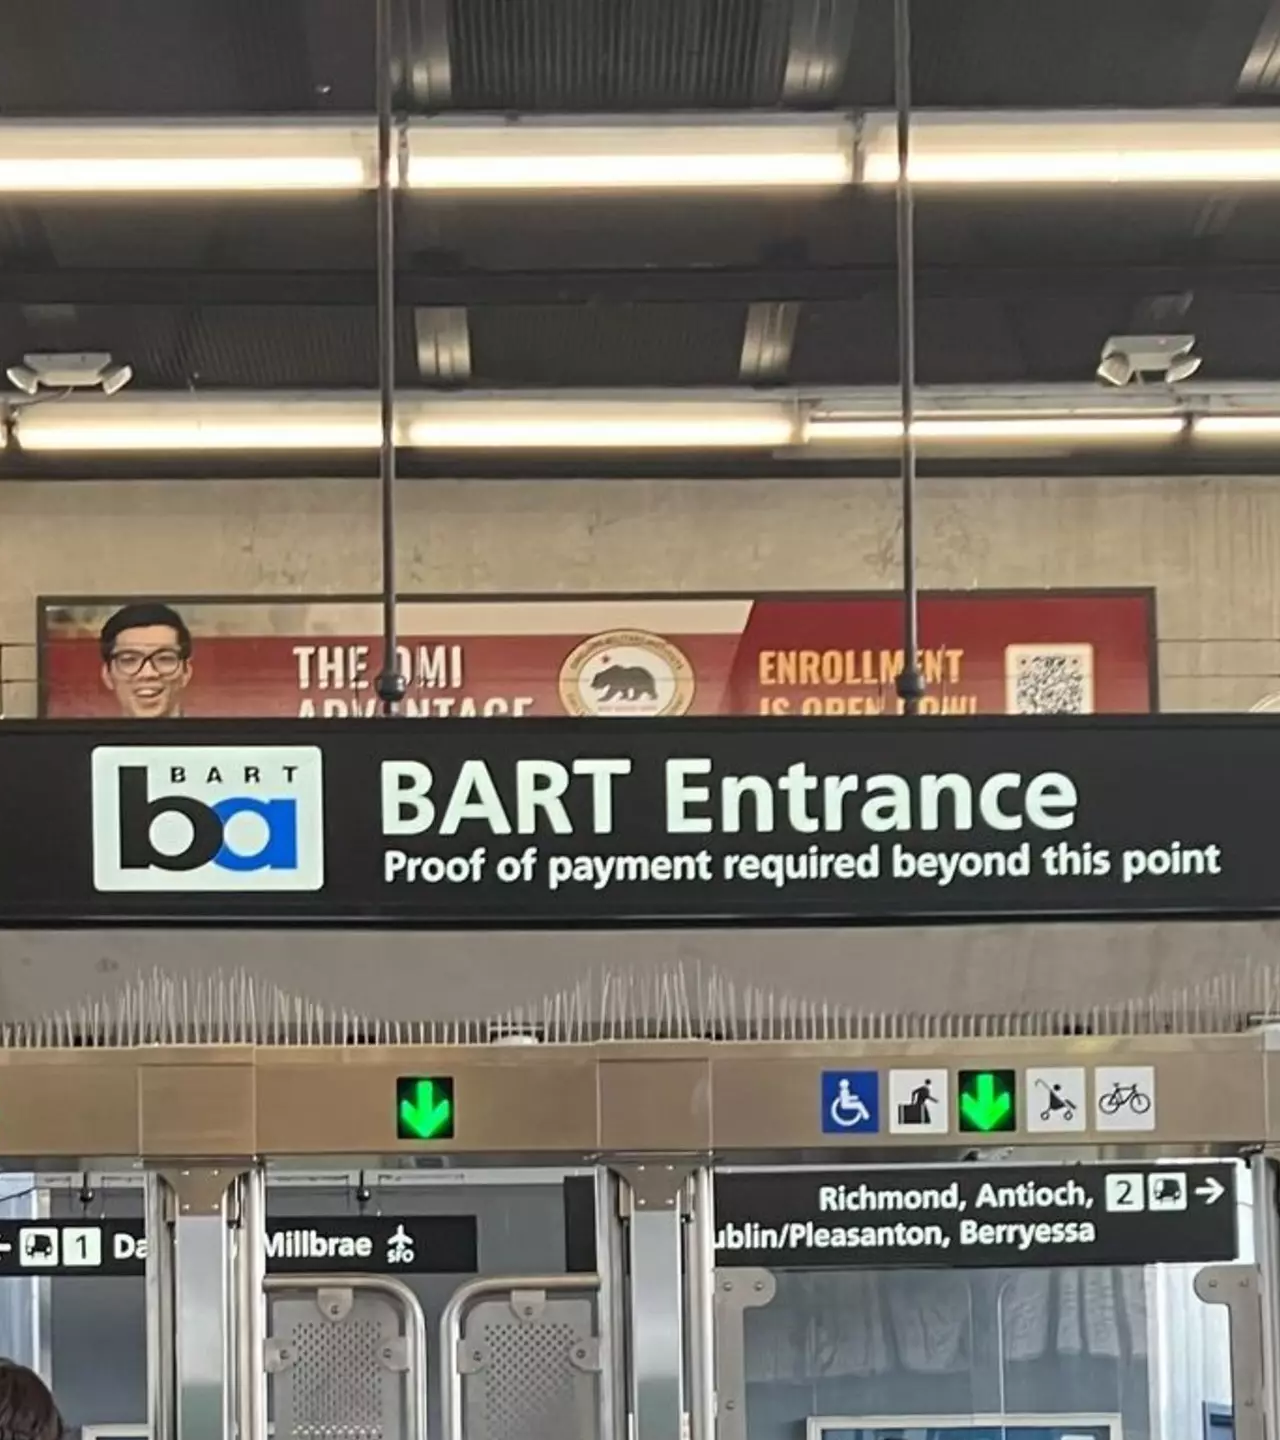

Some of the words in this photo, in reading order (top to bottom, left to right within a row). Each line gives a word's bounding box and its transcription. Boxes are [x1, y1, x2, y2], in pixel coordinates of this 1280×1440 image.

[292, 646, 369, 689] THE
[170, 766, 299, 784] BART
[380, 758, 632, 835] BART
[665, 757, 1078, 834] Entrance
[383, 846, 488, 883] Proof
[496, 846, 539, 882] of
[548, 849, 713, 891] payment
[723, 843, 881, 889] required
[891, 842, 1031, 887] beyond
[1041, 841, 1111, 877] this
[1122, 840, 1221, 883] point
[819, 1182, 966, 1212] Richmond,
[975, 1179, 1093, 1209] Antioch,
[1115, 1179, 1134, 1205] 2
[75, 1234, 87, 1259] 1
[114, 1232, 149, 1259] Da
[264, 1229, 373, 1258] Millbrae
[713, 1220, 951, 1249] ublin/Pleasanton,
[959, 1219, 1096, 1251] Berryessa
